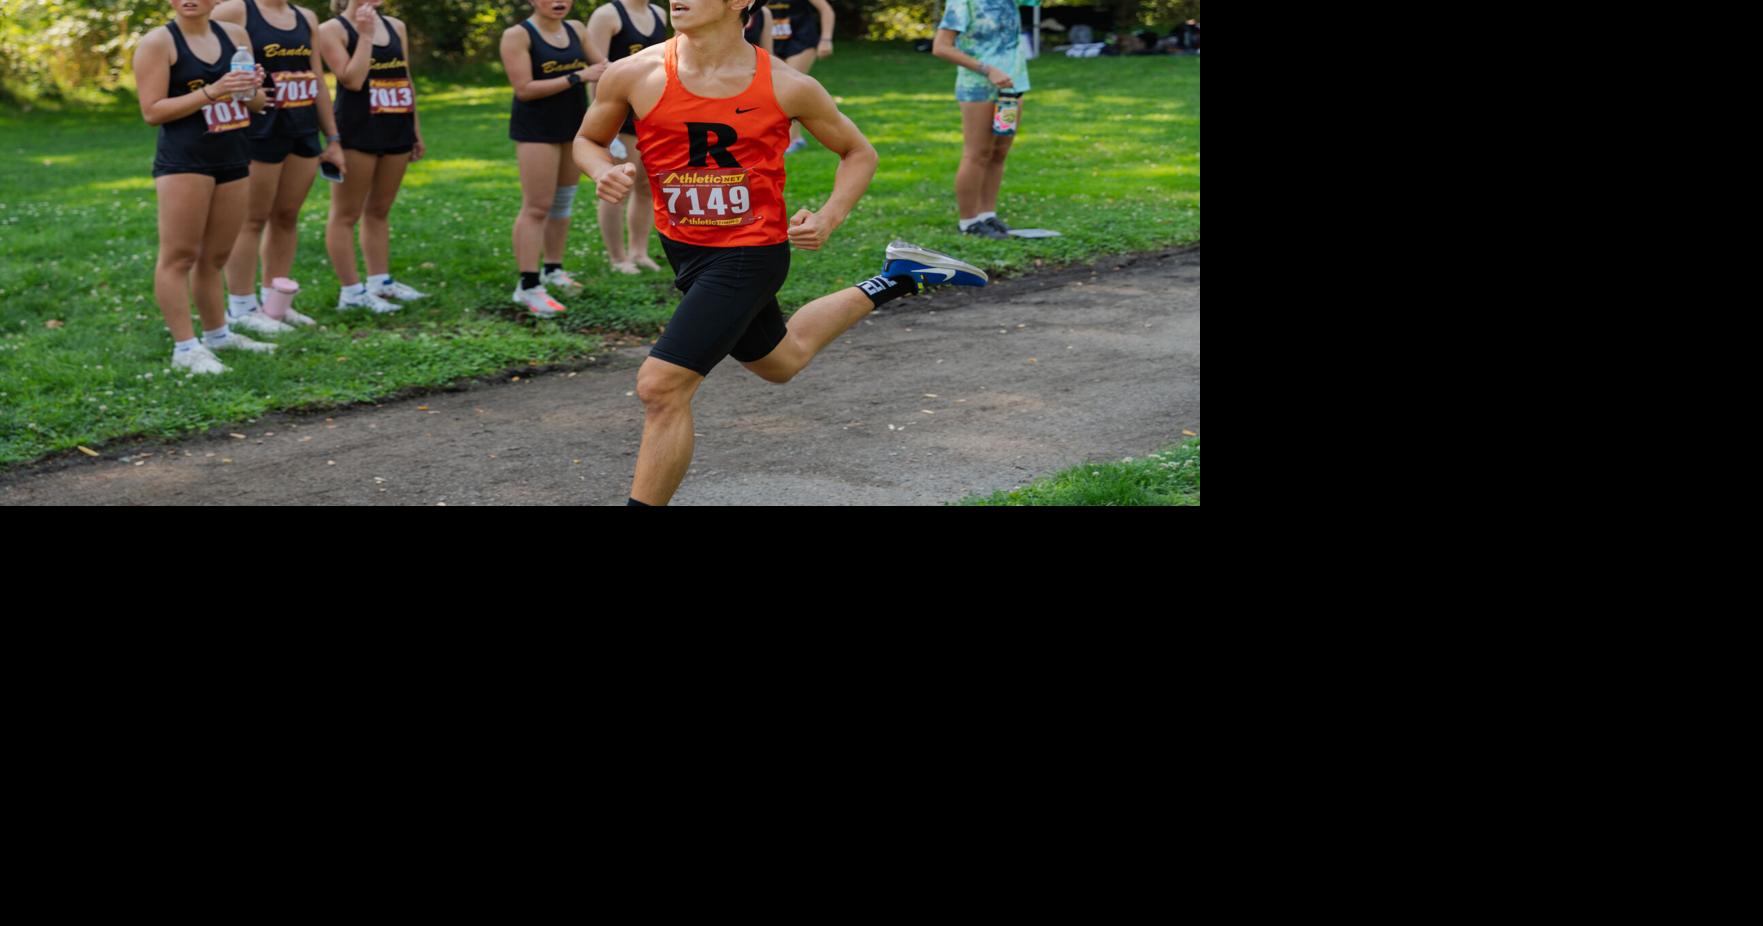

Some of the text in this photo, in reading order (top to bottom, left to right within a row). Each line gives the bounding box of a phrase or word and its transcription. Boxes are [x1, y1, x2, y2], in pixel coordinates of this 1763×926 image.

[276, 80, 318, 101] 7014
[369, 88, 412, 107] 7013
[684, 122, 743, 168] R
[662, 186, 750, 215] 7149
